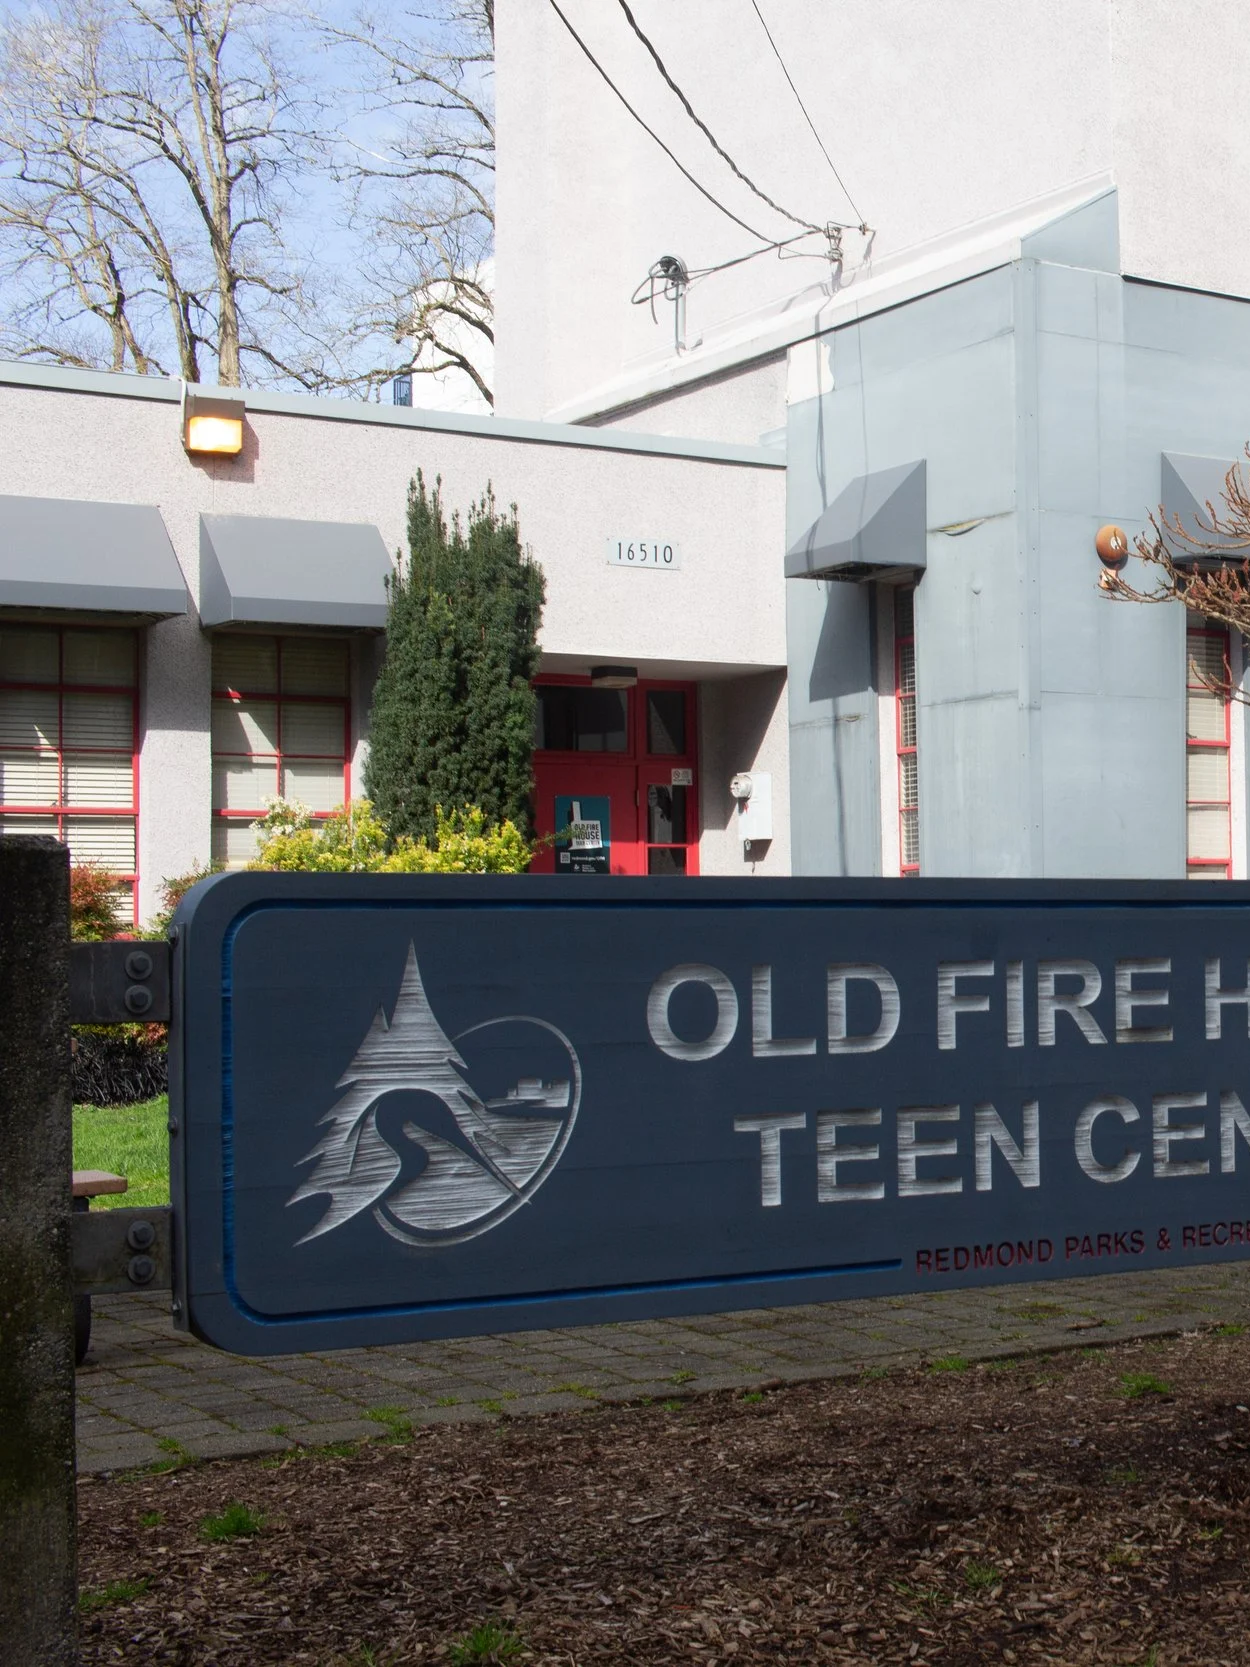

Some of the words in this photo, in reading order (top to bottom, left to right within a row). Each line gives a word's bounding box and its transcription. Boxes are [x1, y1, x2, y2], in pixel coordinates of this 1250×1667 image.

[618, 542, 673, 564] 16510
[586, 823, 600, 831] FIRE
[647, 961, 901, 1062] OLD
[937, 956, 1174, 1050] FIRE
[733, 1100, 1040, 1207] TEEN
[915, 1239, 1054, 1276] REDMOND
[1064, 1229, 1146, 1260] PARKS
[1156, 1227, 1172, 1251] &
